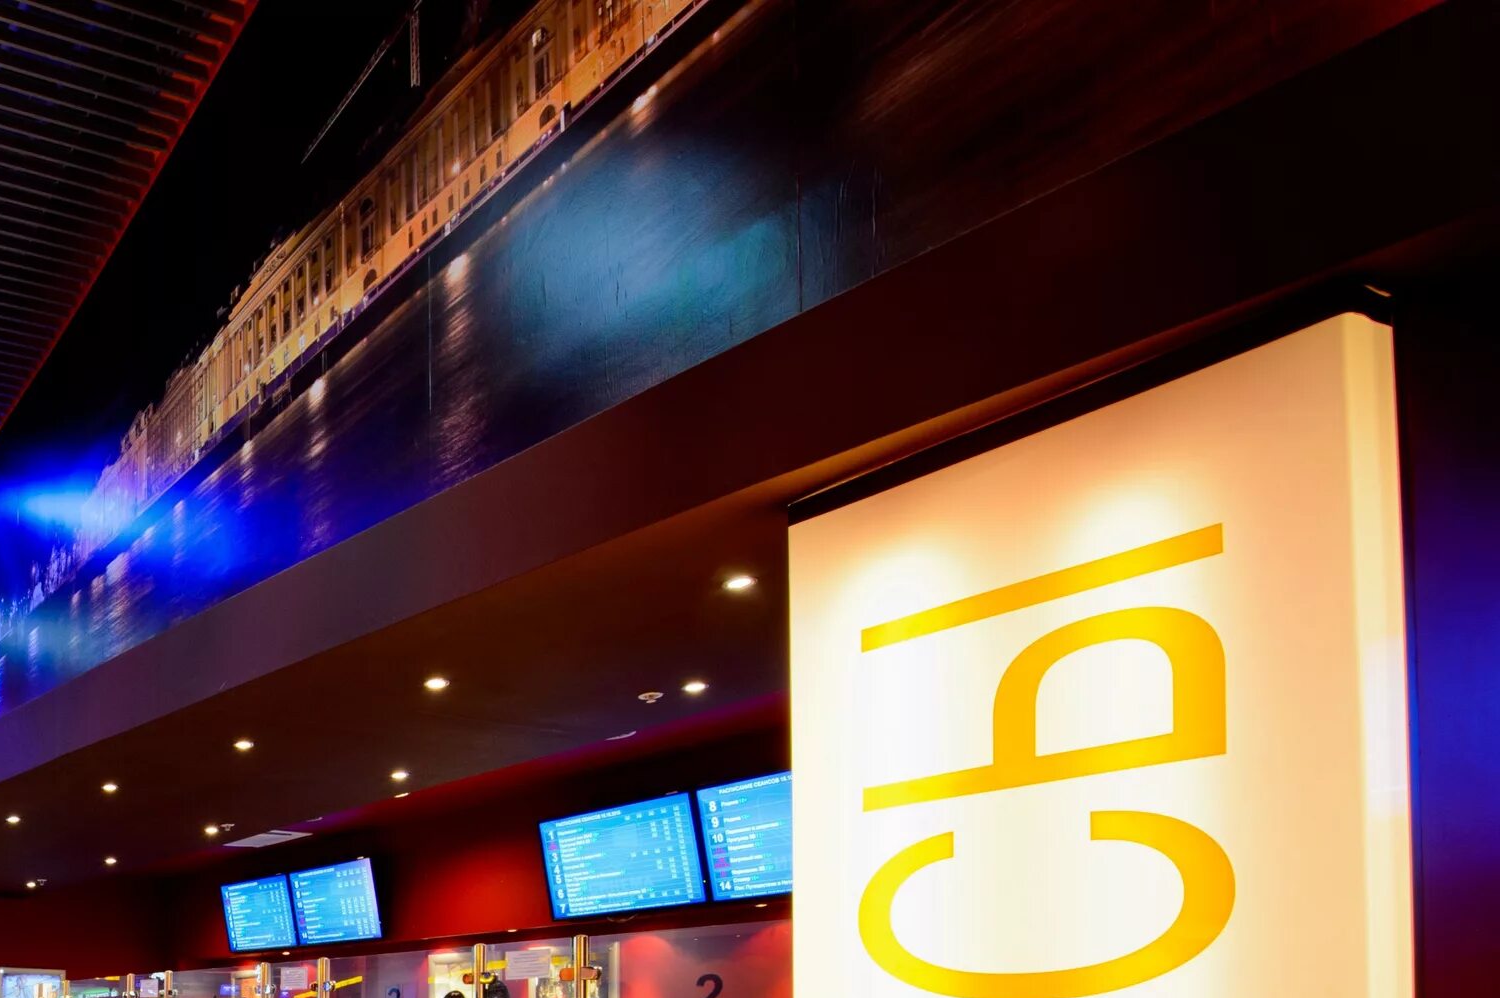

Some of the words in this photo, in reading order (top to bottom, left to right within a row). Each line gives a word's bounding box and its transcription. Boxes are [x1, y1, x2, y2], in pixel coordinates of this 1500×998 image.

[708, 801, 717, 812] 8
[712, 833, 724, 843] 10
[720, 881, 732, 891] 14
